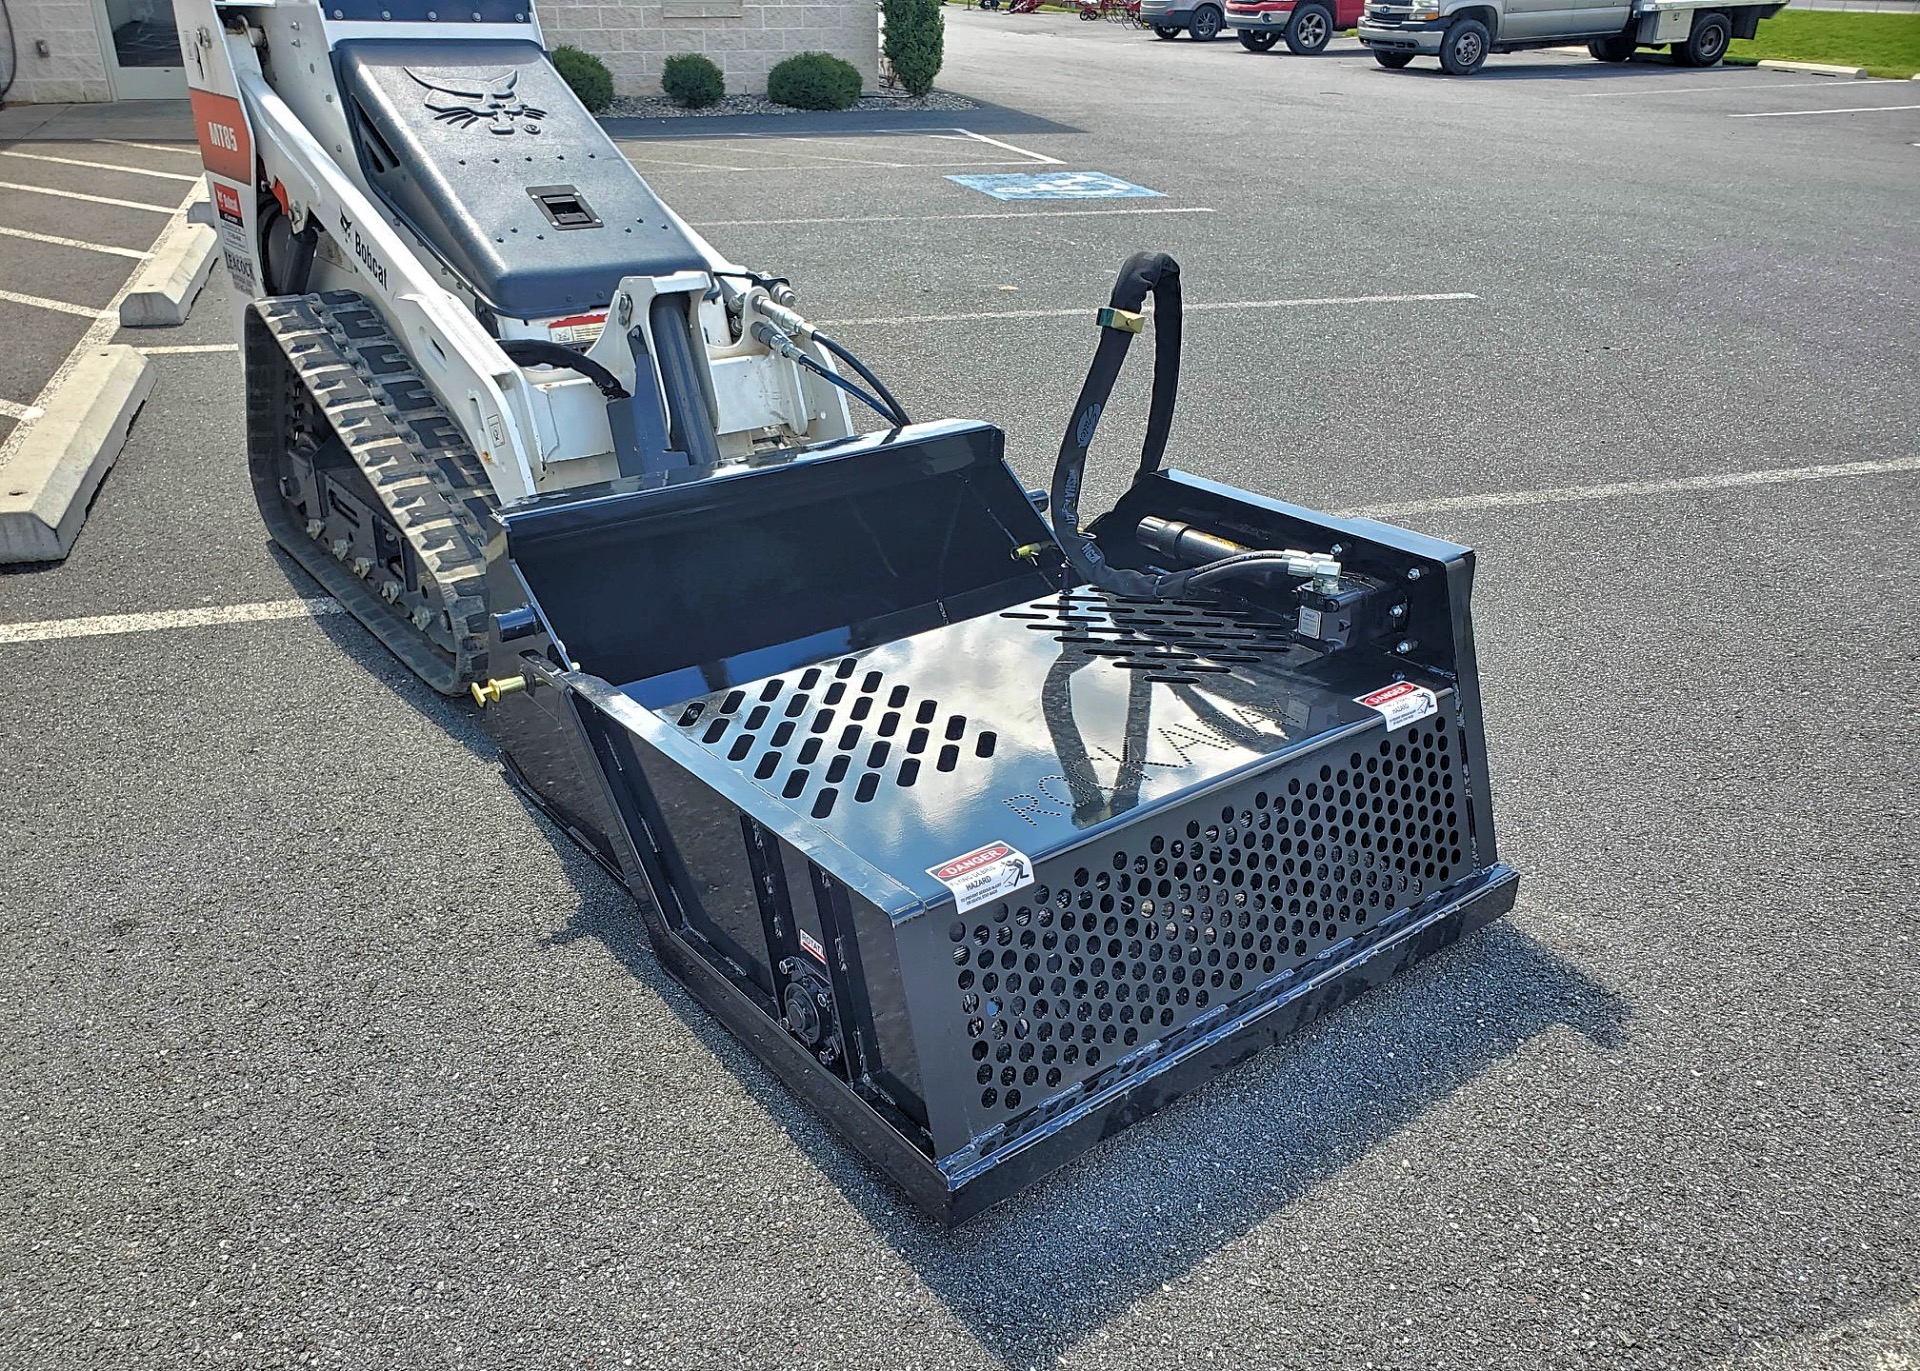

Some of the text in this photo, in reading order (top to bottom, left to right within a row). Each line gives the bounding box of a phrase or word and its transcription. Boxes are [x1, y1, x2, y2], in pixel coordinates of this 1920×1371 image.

[208, 121, 238, 152] MT85
[355, 230, 388, 291] Bobcat
[1368, 685, 1409, 705] DANGER
[946, 849, 1002, 875] DANGER
[966, 875, 992, 891] HAZARD
